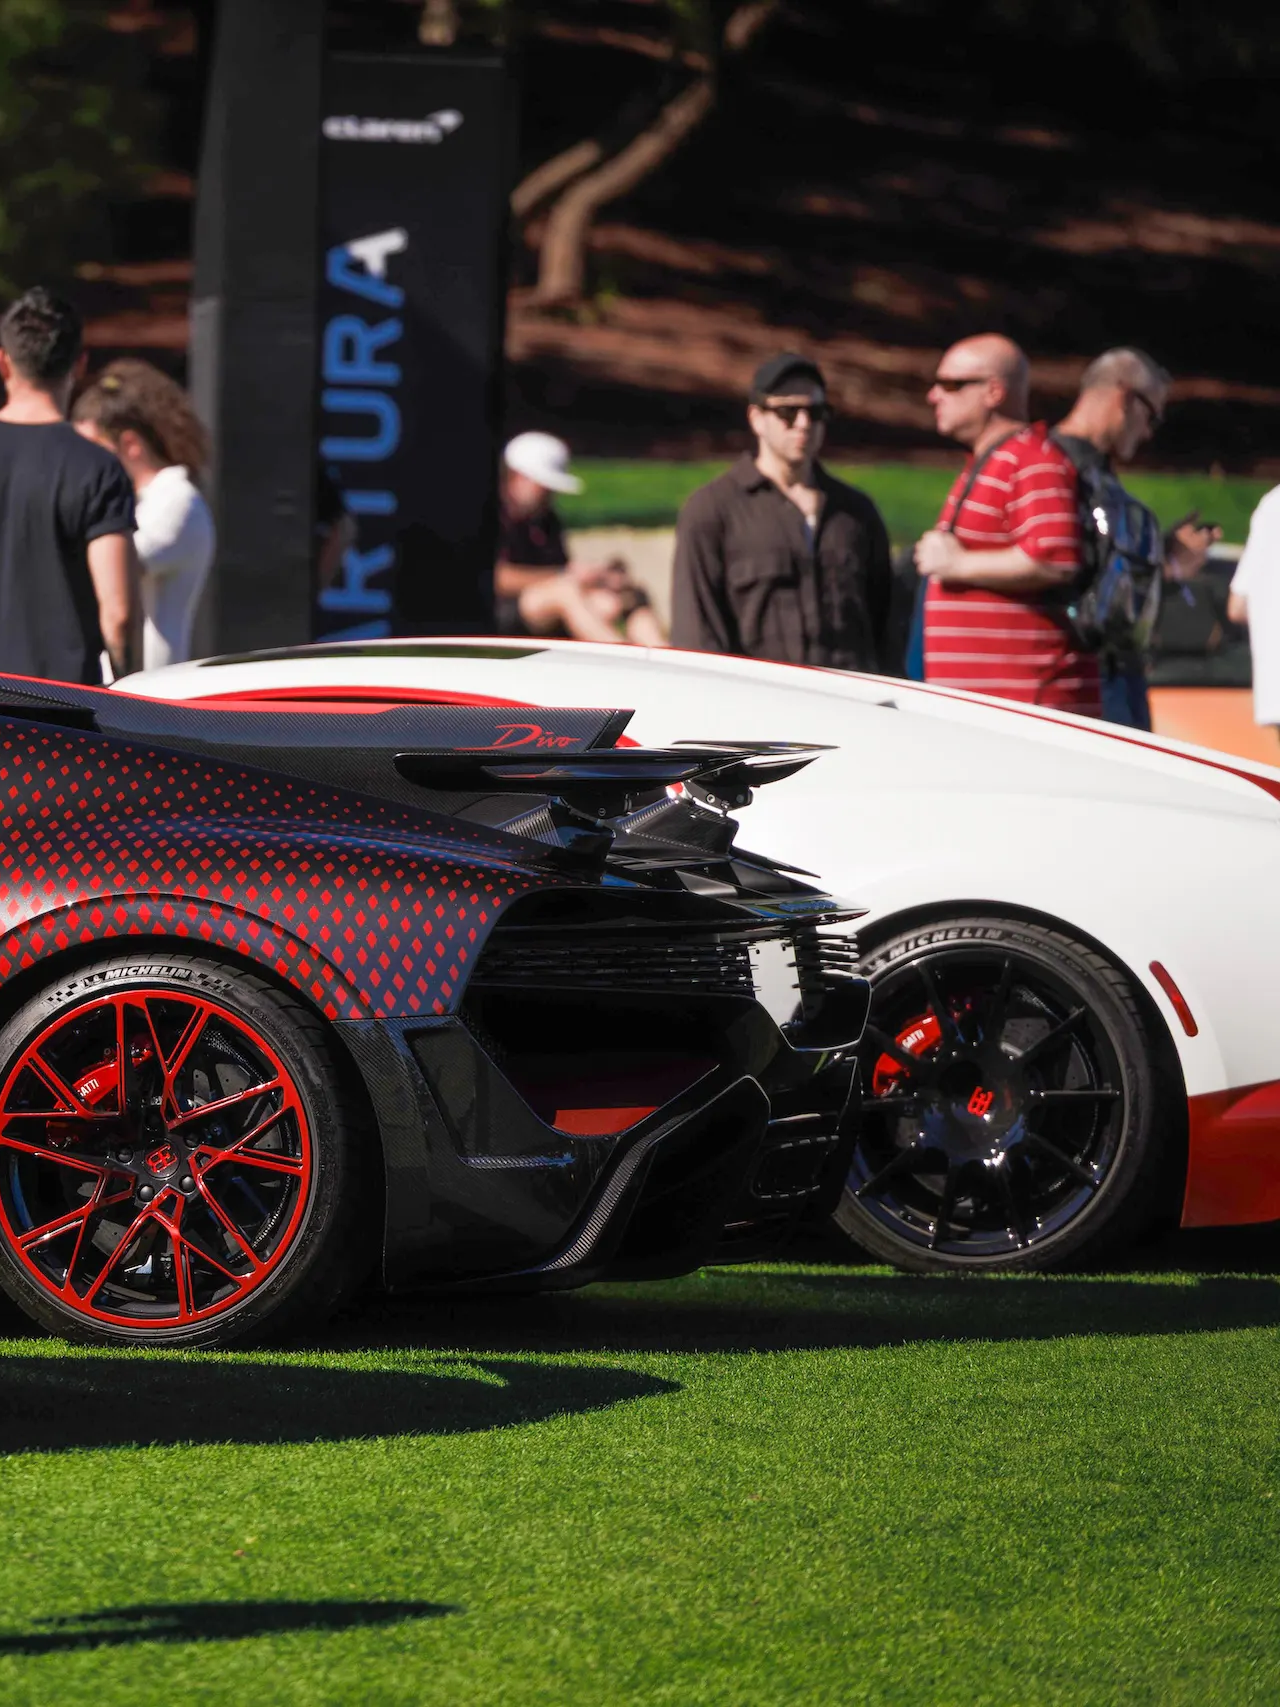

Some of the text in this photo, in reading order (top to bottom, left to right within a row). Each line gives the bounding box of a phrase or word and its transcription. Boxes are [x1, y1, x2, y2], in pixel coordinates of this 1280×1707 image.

[455, 723, 580, 751] Divo
[889, 928, 1002, 959] MICHELIN
[105, 965, 192, 981] MICHELIN
